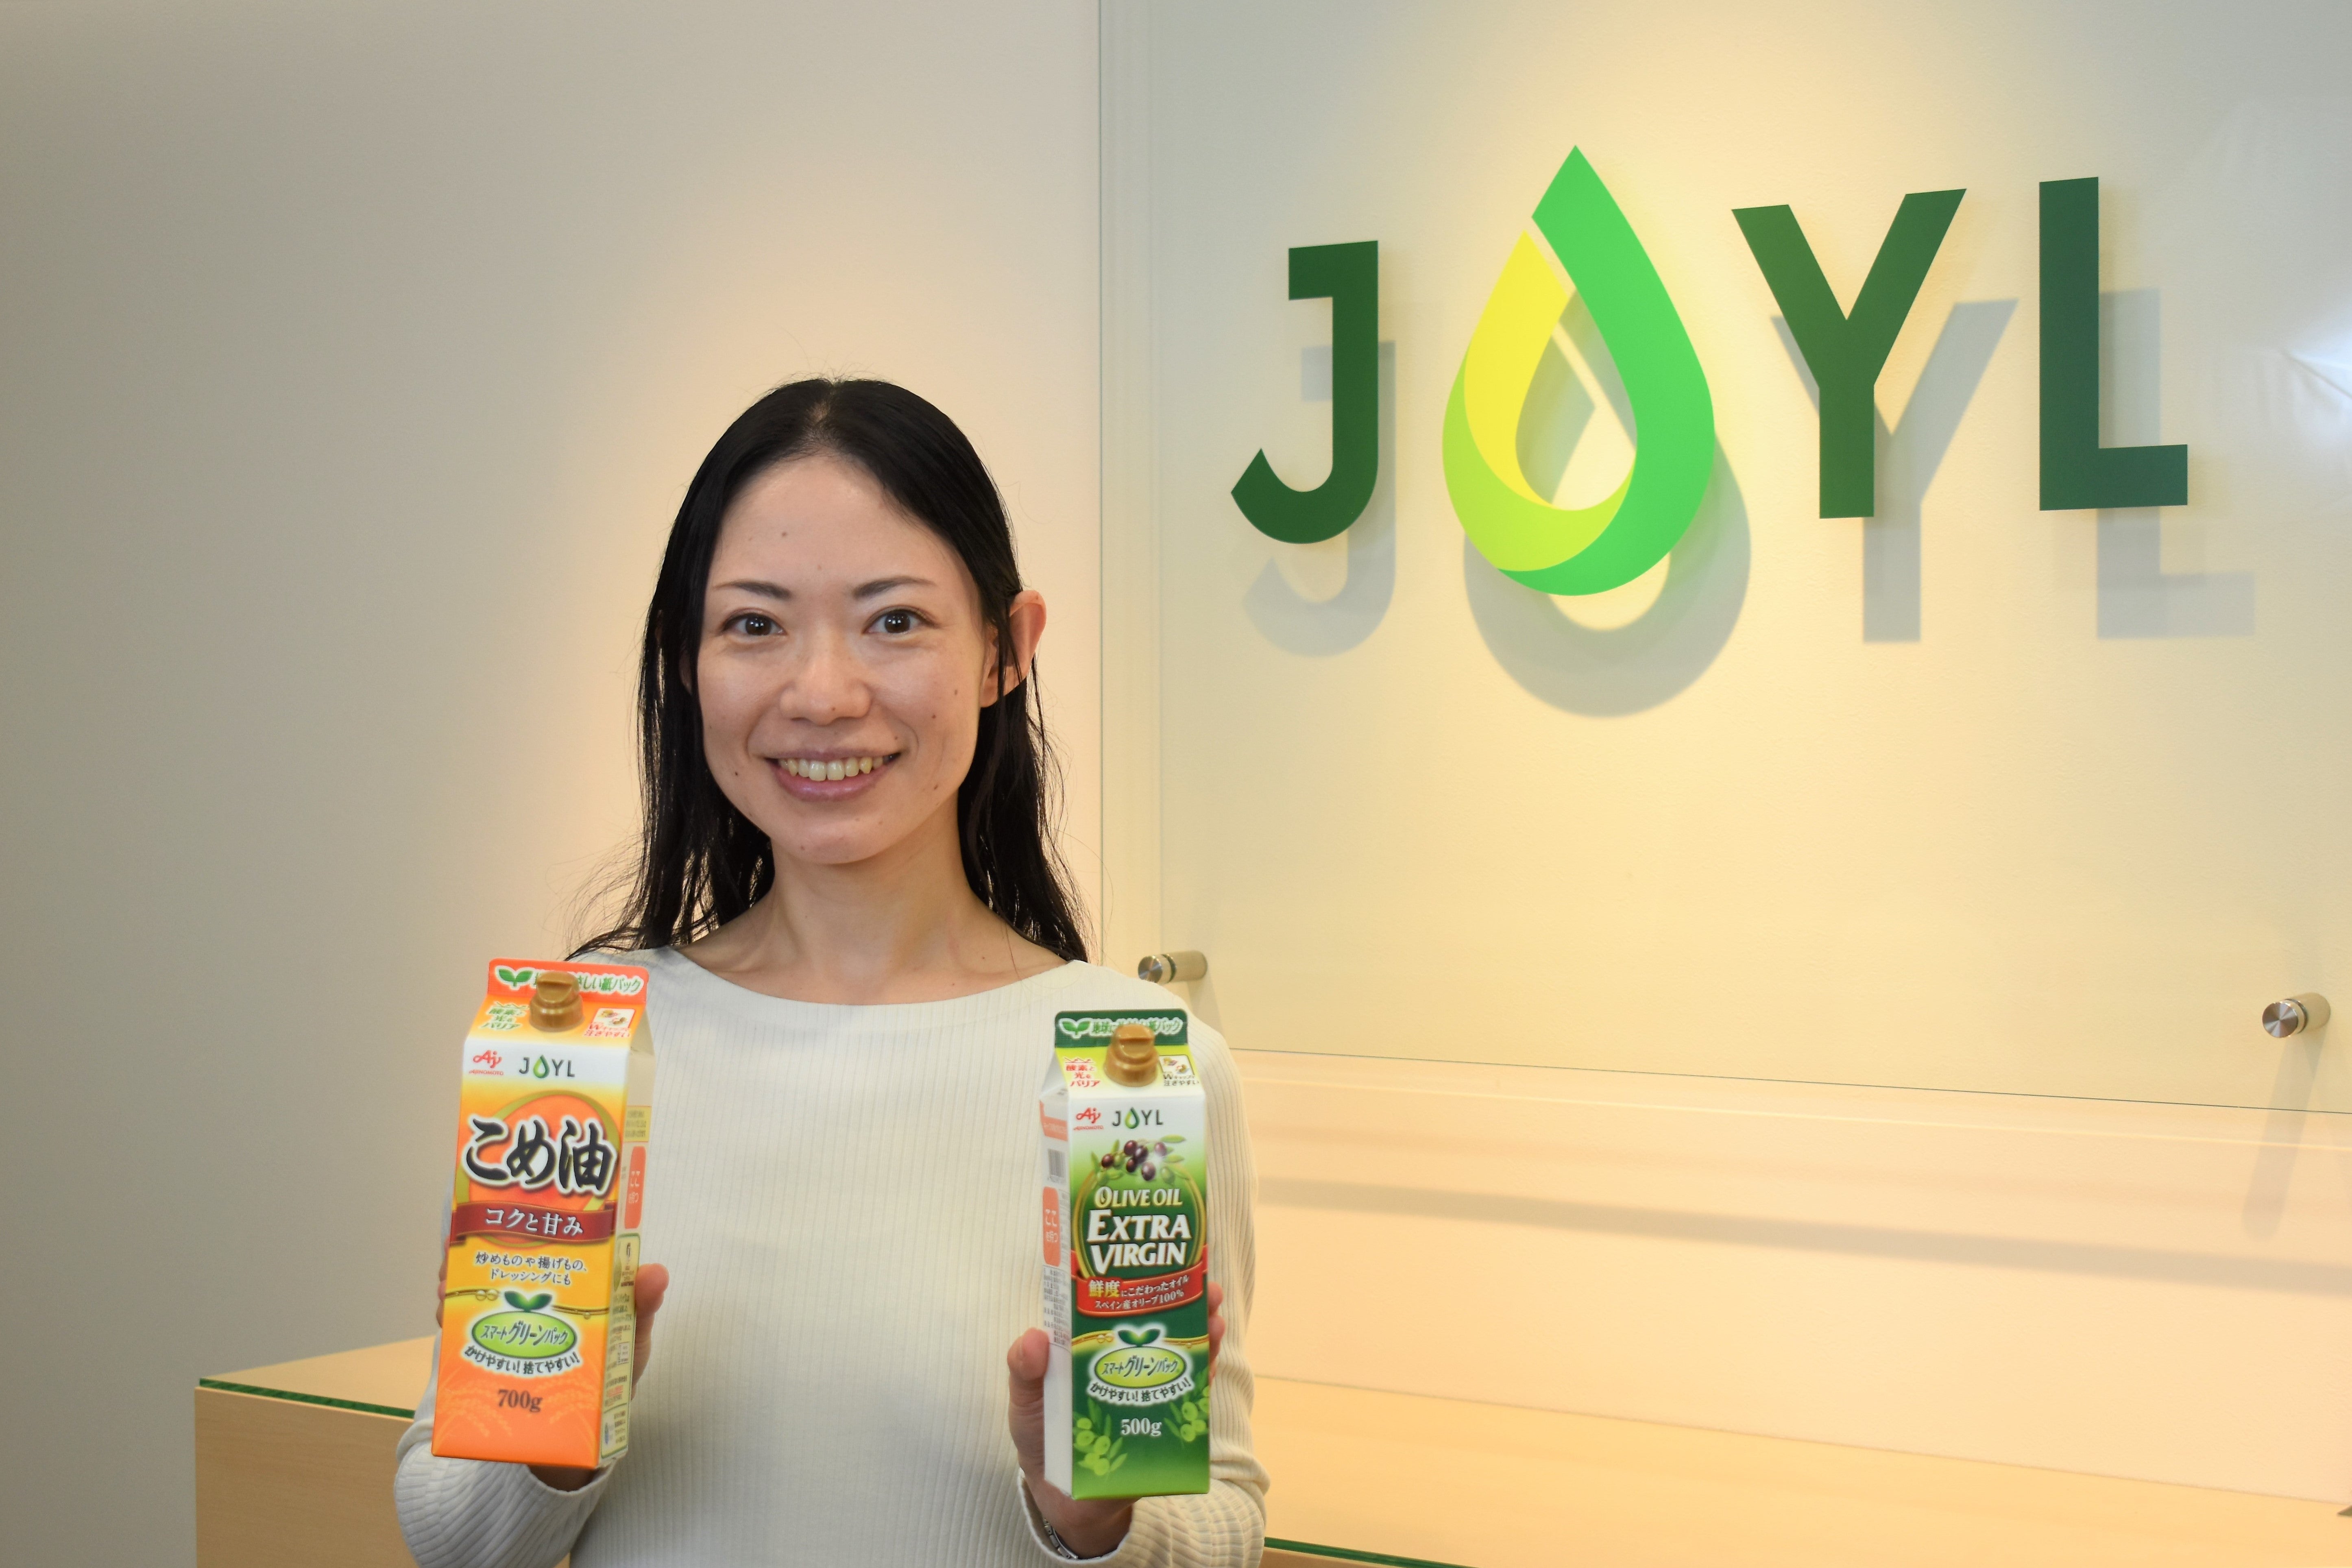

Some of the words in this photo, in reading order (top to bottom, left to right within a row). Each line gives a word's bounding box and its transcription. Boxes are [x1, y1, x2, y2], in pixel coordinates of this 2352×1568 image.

[1231, 144, 2187, 595] JOYL
[519, 1054, 575, 1078] JOYL
[1112, 1107, 1163, 1129] JOYL
[466, 1118, 613, 1190] こめ油
[1094, 1186, 1151, 1208] OLIVE
[1153, 1188, 1183, 1206] OIL
[486, 1208, 583, 1236] コクと甘み
[1086, 1209, 1192, 1242] EXTRA
[1090, 1242, 1188, 1275] VIRGIN
[491, 1268, 571, 1285] ドレッシングにも
[480, 1320, 568, 1346] スマートグリーンパック
[1102, 1355, 1178, 1377] スマートグリーンパック
[498, 1389, 543, 1412] 700g
[1121, 1418, 1162, 1436] 500g
